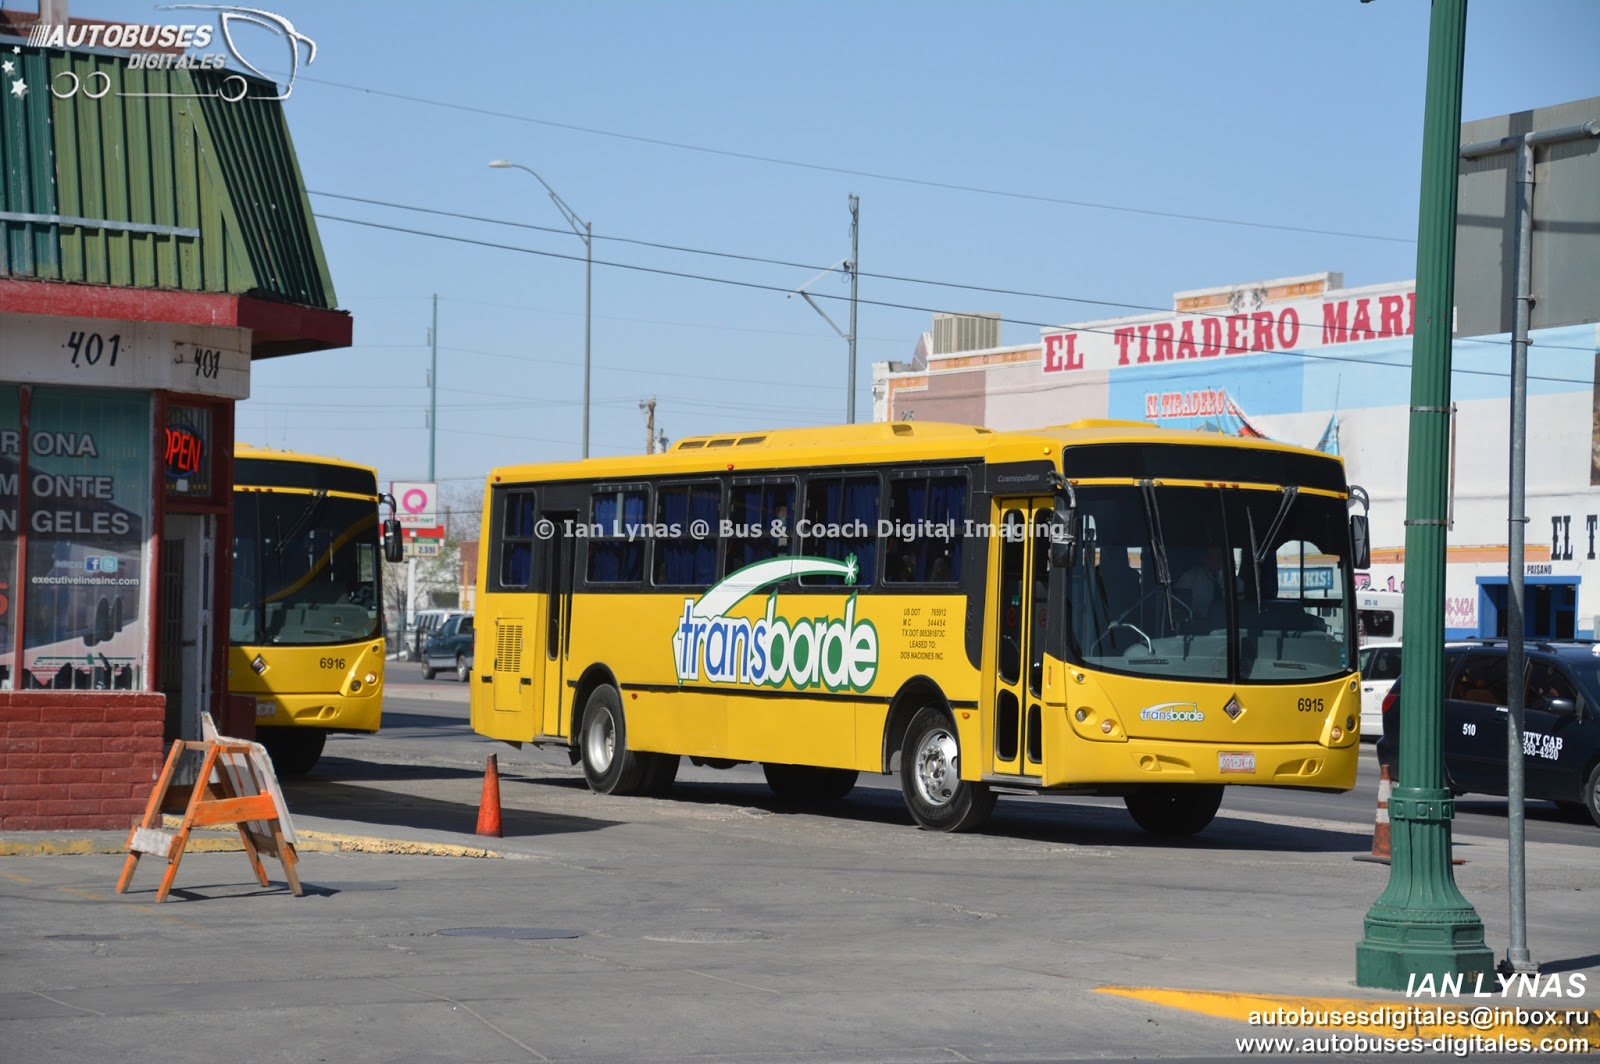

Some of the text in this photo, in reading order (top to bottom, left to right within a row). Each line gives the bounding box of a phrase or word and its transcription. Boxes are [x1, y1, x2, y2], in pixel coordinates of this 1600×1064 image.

[1043, 333, 1084, 373] EL
[1114, 307, 1300, 366] TIRADERO
[67, 331, 120, 367] 401
[193, 347, 221, 379] 401
[1161, 389, 1226, 418] TIRADERO
[997, 474, 1040, 484] Cosmopolitan
[1551, 515, 1574, 561] EL
[1526, 564, 1552, 575] PAISANO
[32, 576, 139, 587] executivelinesinc.com
[672, 588, 879, 693] transborde
[909, 640, 928, 649] LEASED
[319, 657, 346, 670] 6916
[1297, 698, 1324, 712] 6915
[1141, 708, 1205, 722] transborde
[1462, 723, 1476, 736] 510
[1542, 734, 1563, 750] CAB
